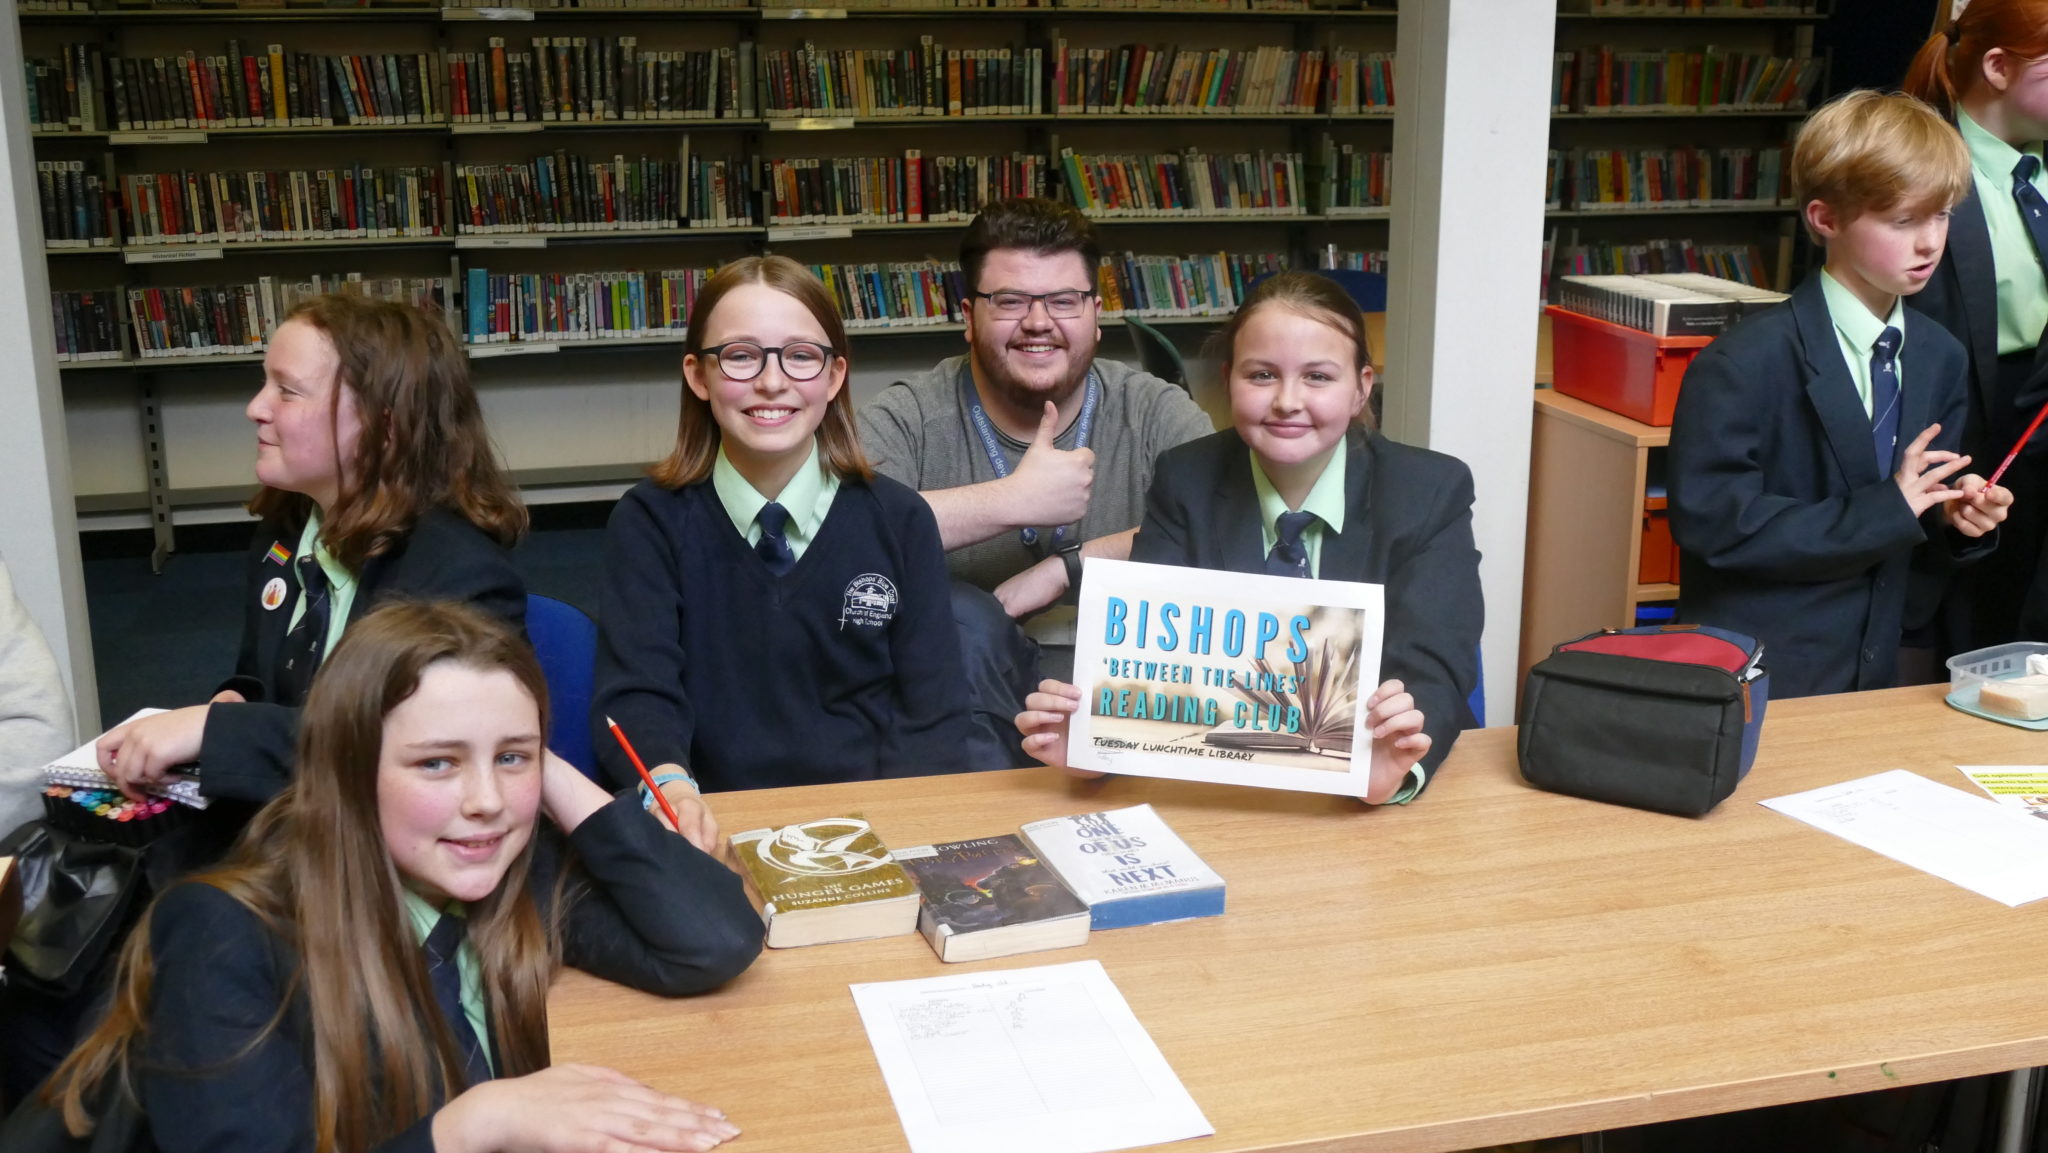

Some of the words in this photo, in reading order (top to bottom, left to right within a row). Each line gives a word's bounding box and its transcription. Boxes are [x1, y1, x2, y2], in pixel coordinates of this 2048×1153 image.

[1081, 374, 1096, 430] development
[972, 404, 999, 457] Outstanding
[869, 611, 892, 619] England
[1104, 596, 1311, 663] BISHOPS
[1202, 666, 1236, 688] THE
[1100, 687, 1218, 726] READING
[1233, 701, 1301, 733] CLUB
[1093, 736, 1140, 750] TUESDAY
[1143, 743, 1204, 756] LUNCHTIME
[1208, 749, 1254, 761] LIBRARY
[1076, 823, 1125, 839] ONE
[1079, 841, 1109, 854] OF
[1112, 836, 1147, 850] US
[1114, 853, 1141, 866] IS
[1108, 864, 1177, 887] NEXT
[772, 887, 844, 902] HUNGER
[848, 877, 904, 892] GAMES
[791, 895, 842, 906] SUZANNE
[845, 888, 892, 899] COLLINS
